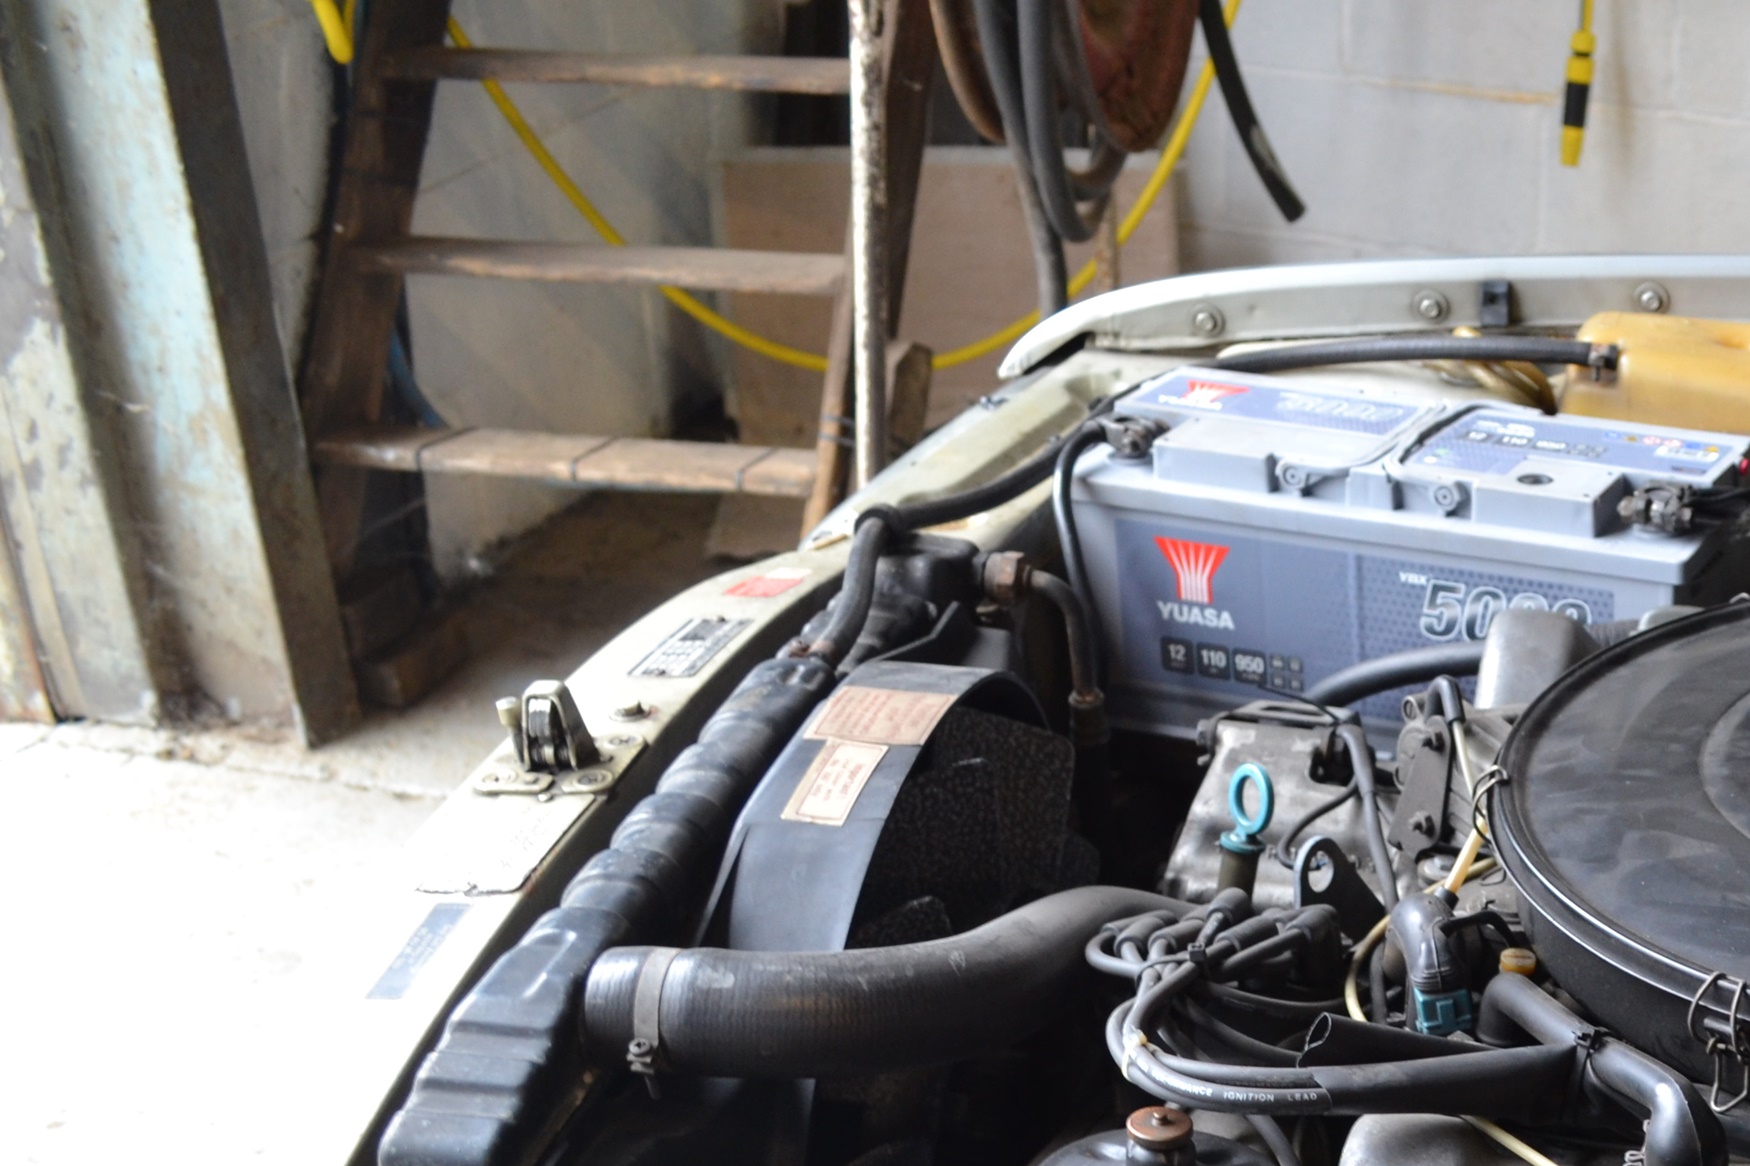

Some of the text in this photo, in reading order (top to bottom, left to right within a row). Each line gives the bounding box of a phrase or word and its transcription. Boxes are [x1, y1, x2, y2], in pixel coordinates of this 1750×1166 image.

[1156, 599, 1236, 631] YUASA
[1168, 642, 1187, 662] 12
[1200, 648, 1228, 669] 110
[1234, 653, 1266, 674] 950
[1223, 1091, 1275, 1102] IGNITION
[1287, 1091, 1318, 1101] LEAD
